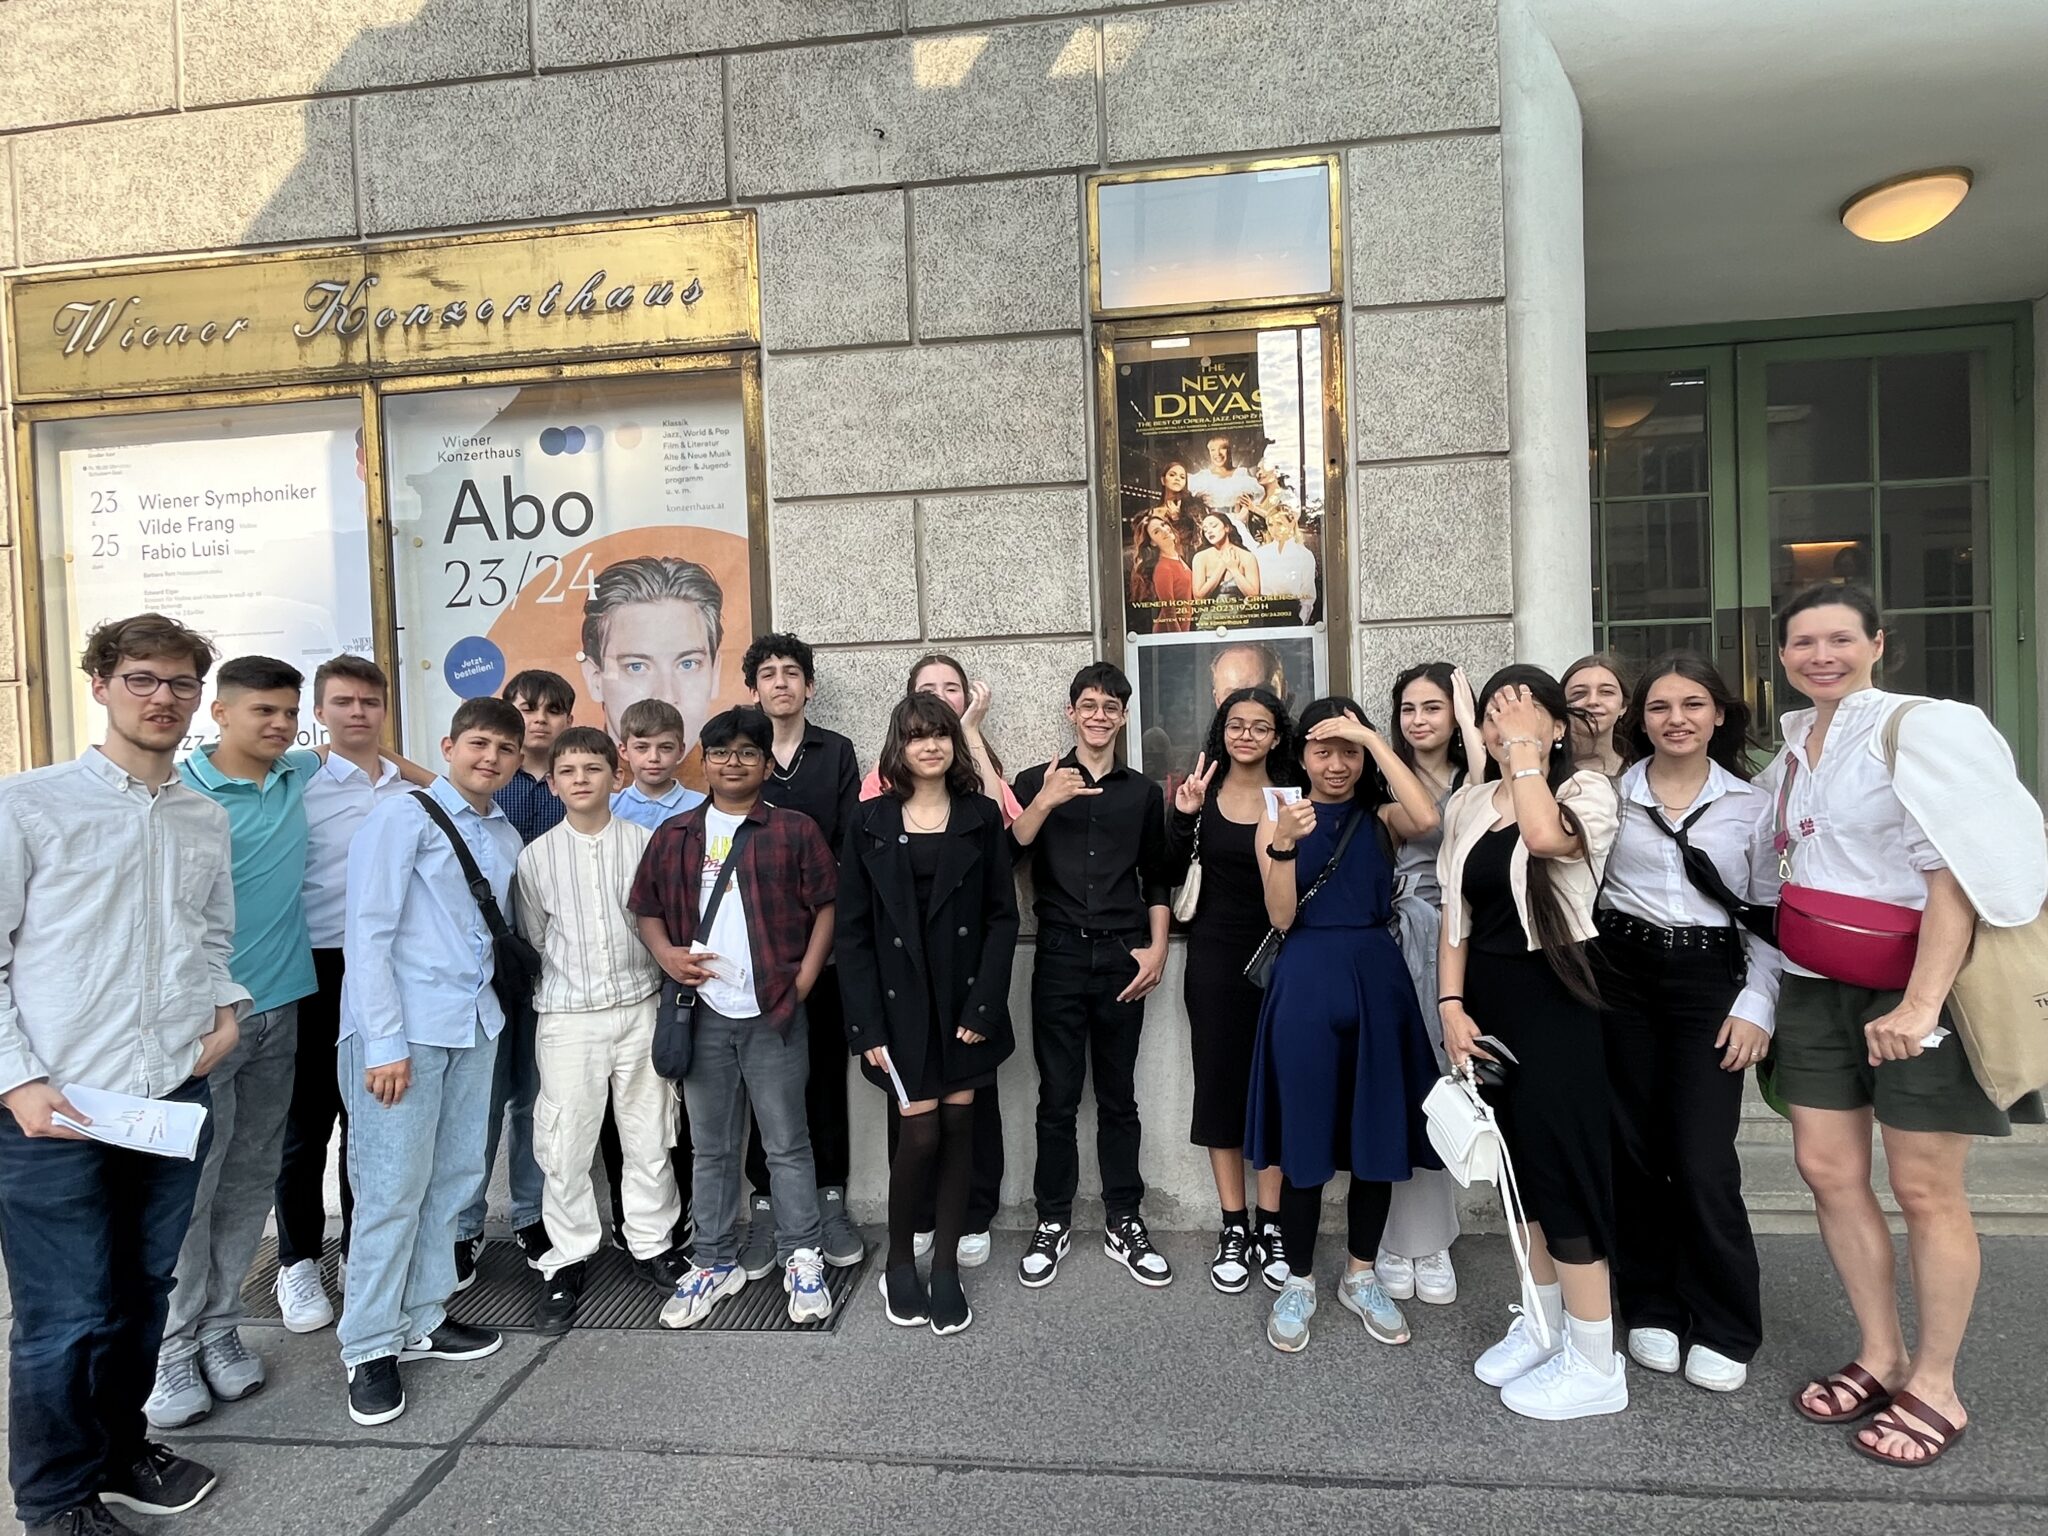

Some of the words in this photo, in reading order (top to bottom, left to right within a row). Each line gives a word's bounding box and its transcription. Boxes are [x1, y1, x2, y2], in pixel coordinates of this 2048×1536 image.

[53, 295, 249, 356] Wiener
[293, 269, 704, 338] Konzerthaus
[1202, 362, 1225, 373] THE
[1182, 372, 1246, 392] NEW
[1154, 389, 1263, 418] DIVAS
[662, 419, 688, 427] Klassik
[662, 431, 682, 439] Jazz,
[683, 429, 706, 437] World
[708, 428, 713, 436] &
[715, 427, 730, 436] Pop
[443, 436, 491, 449] Wiener
[687, 440, 719, 448] Literatur
[437, 447, 521, 463] Konzerthaus
[664, 453, 679, 461] Alte
[709, 449, 731, 458] Musik
[665, 475, 703, 484] programm
[91, 490, 118, 514] 23
[138, 493, 200, 510] Wiener
[205, 484, 317, 509] Symphoniker
[443, 475, 594, 544] Abo
[666, 502, 725, 512] konzerthaus.at
[139, 517, 182, 535] Vilde
[188, 516, 235, 533] Frang
[91, 533, 119, 557] 25
[142, 542, 186, 560] Fabio
[192, 539, 230, 557] Luisi
[444, 551, 600, 611] 23/24
[1132, 600, 1167, 609] WIENER
[1169, 596, 1237, 607] KONZERTHAUS
[1211, 604, 1234, 613] 2023
[454, 661, 494, 680] bestellen!
[461, 657, 483, 668] Jetzt
